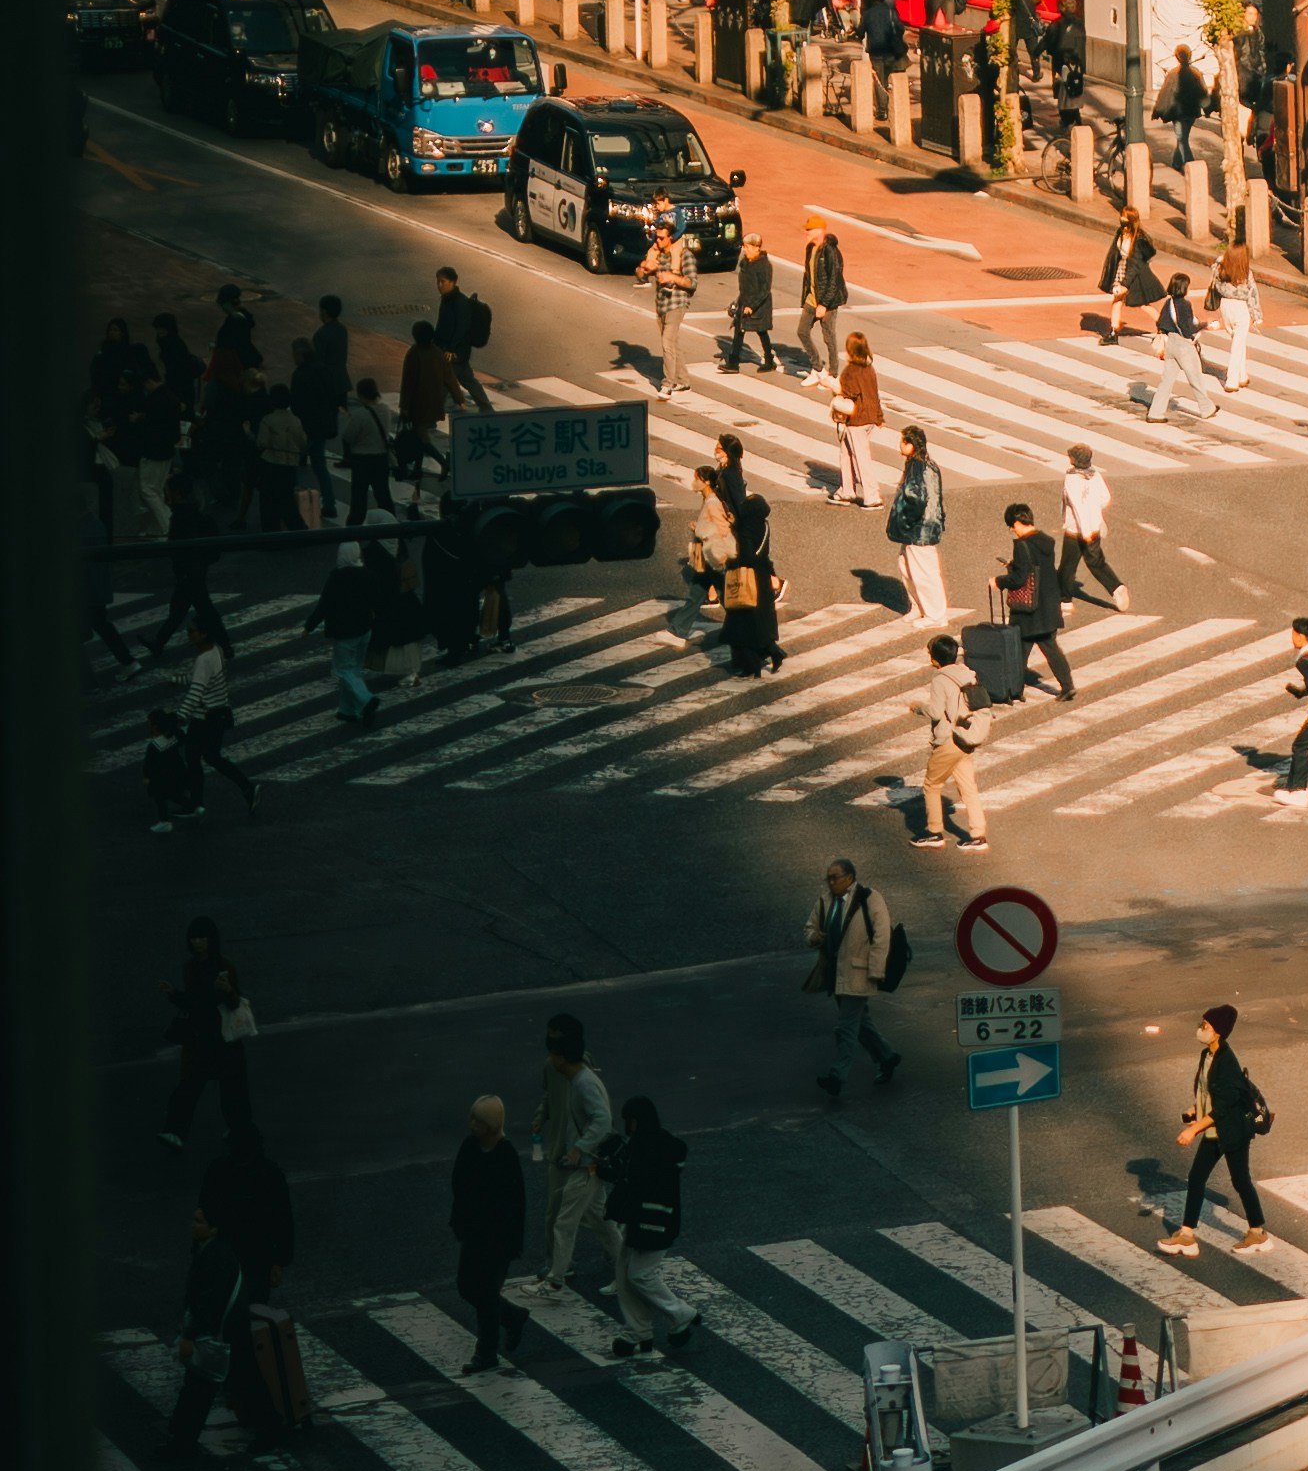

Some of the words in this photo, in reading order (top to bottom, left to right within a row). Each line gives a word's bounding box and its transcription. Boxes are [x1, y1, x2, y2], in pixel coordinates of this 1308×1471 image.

[468, 414, 631, 462] 渋谷駅前
[494, 463, 568, 484] Shibuya
[577, 458, 614, 478] Sta.
[961, 994, 1056, 1016] 路線バスを除く
